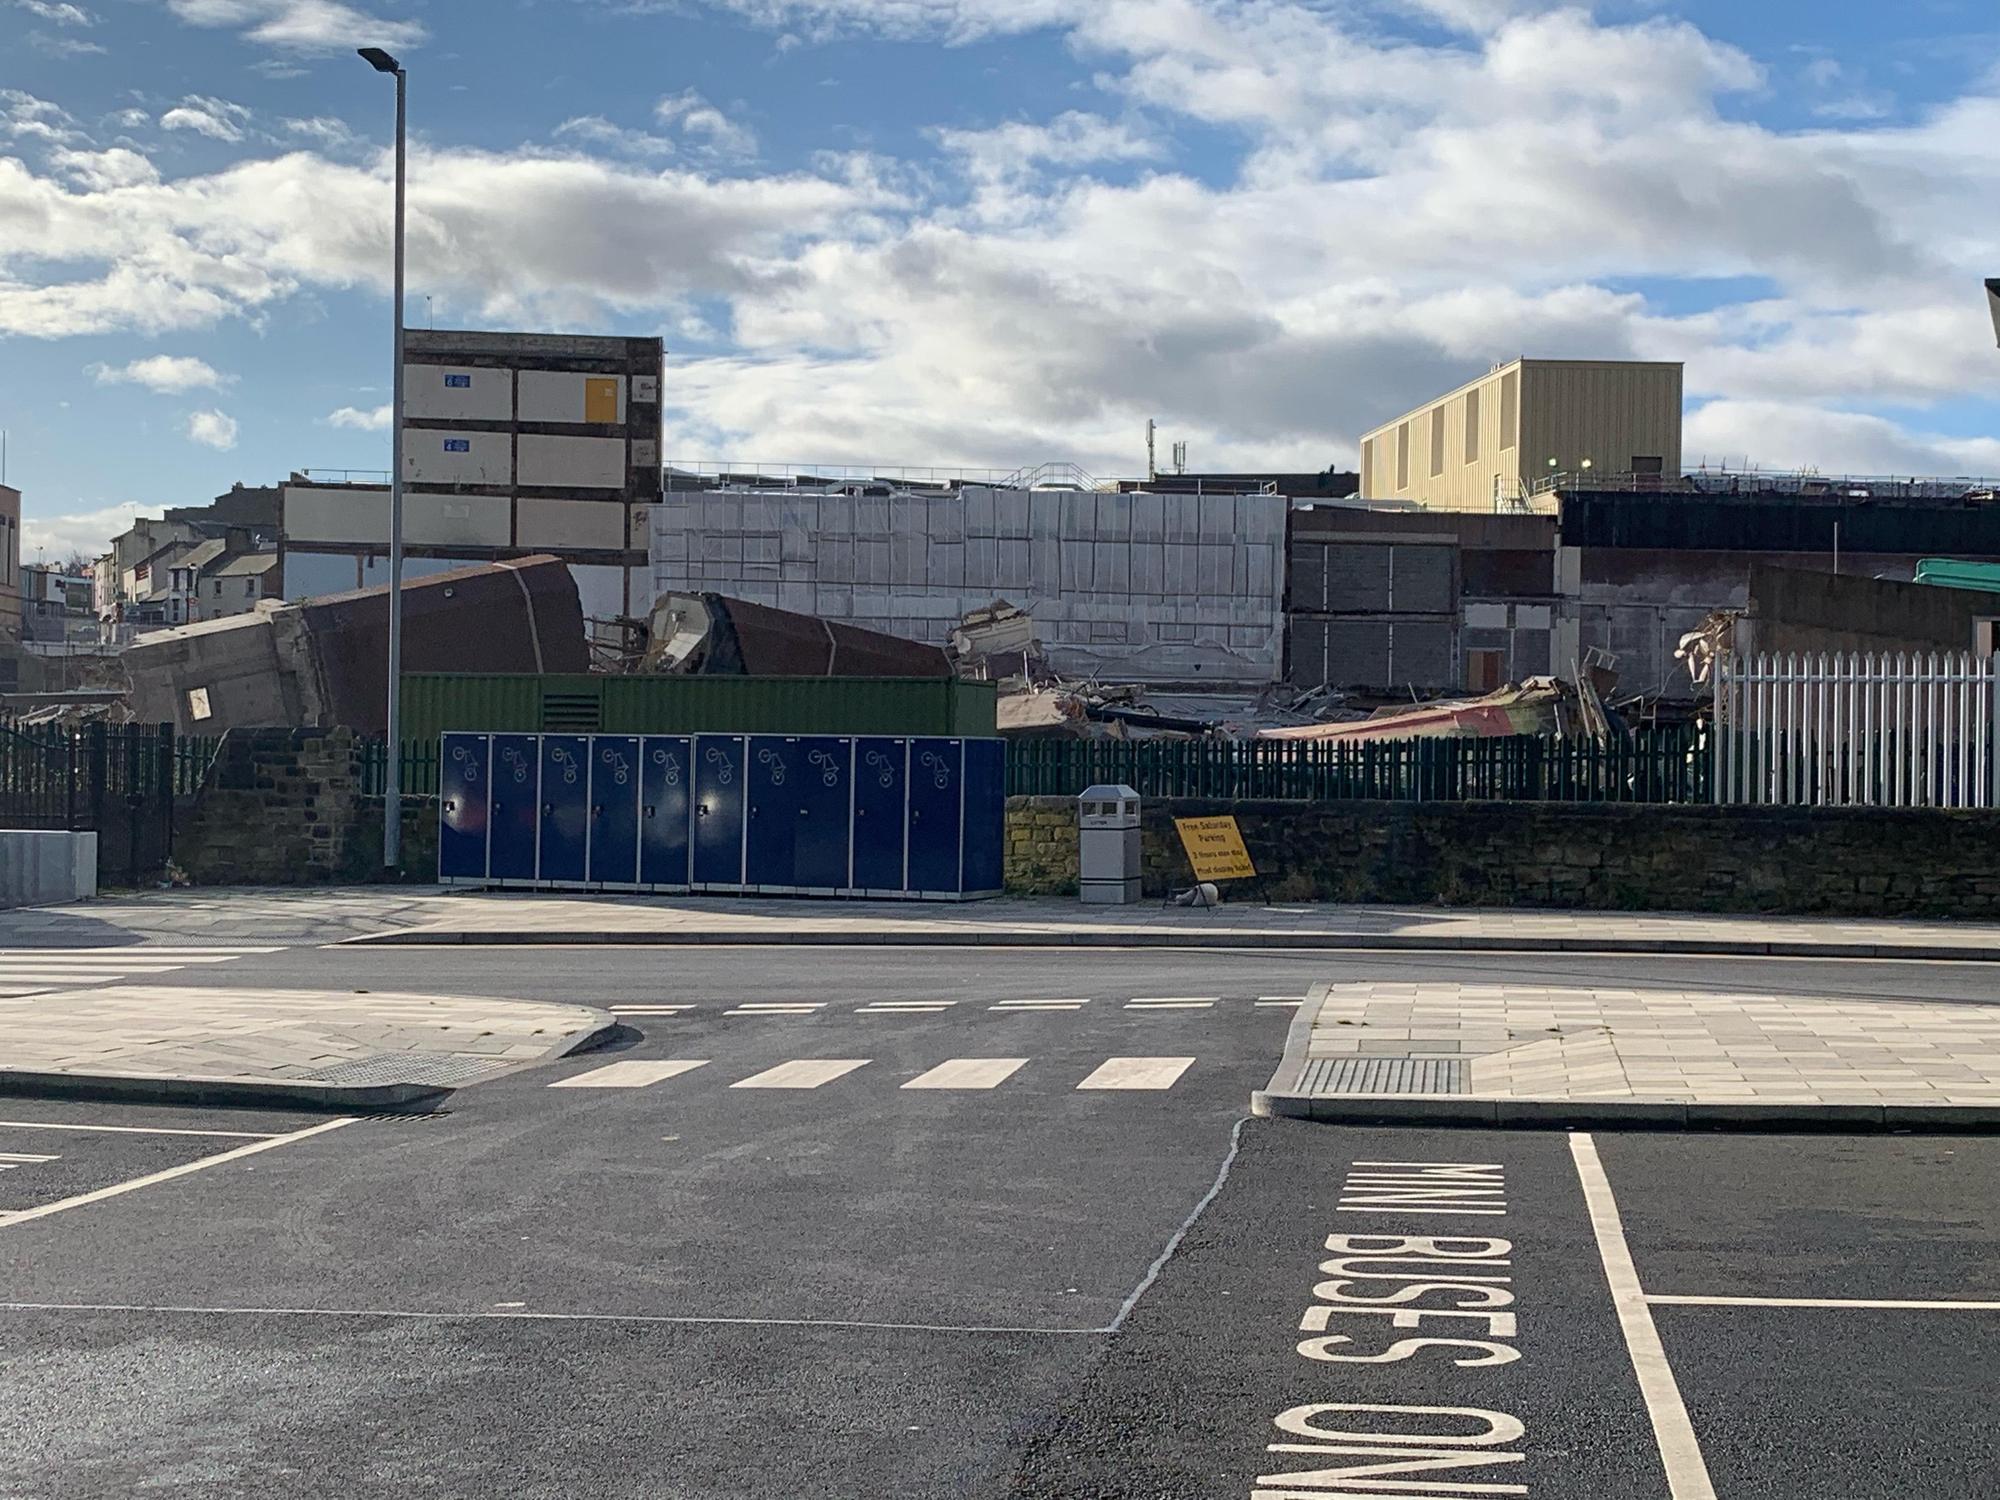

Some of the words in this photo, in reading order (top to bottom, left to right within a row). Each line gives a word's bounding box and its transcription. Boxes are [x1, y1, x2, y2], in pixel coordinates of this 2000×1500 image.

[1198, 834, 1226, 843] Parking
[1336, 1161, 1507, 1215] MINI
[1297, 1233, 1522, 1367] BUSES
